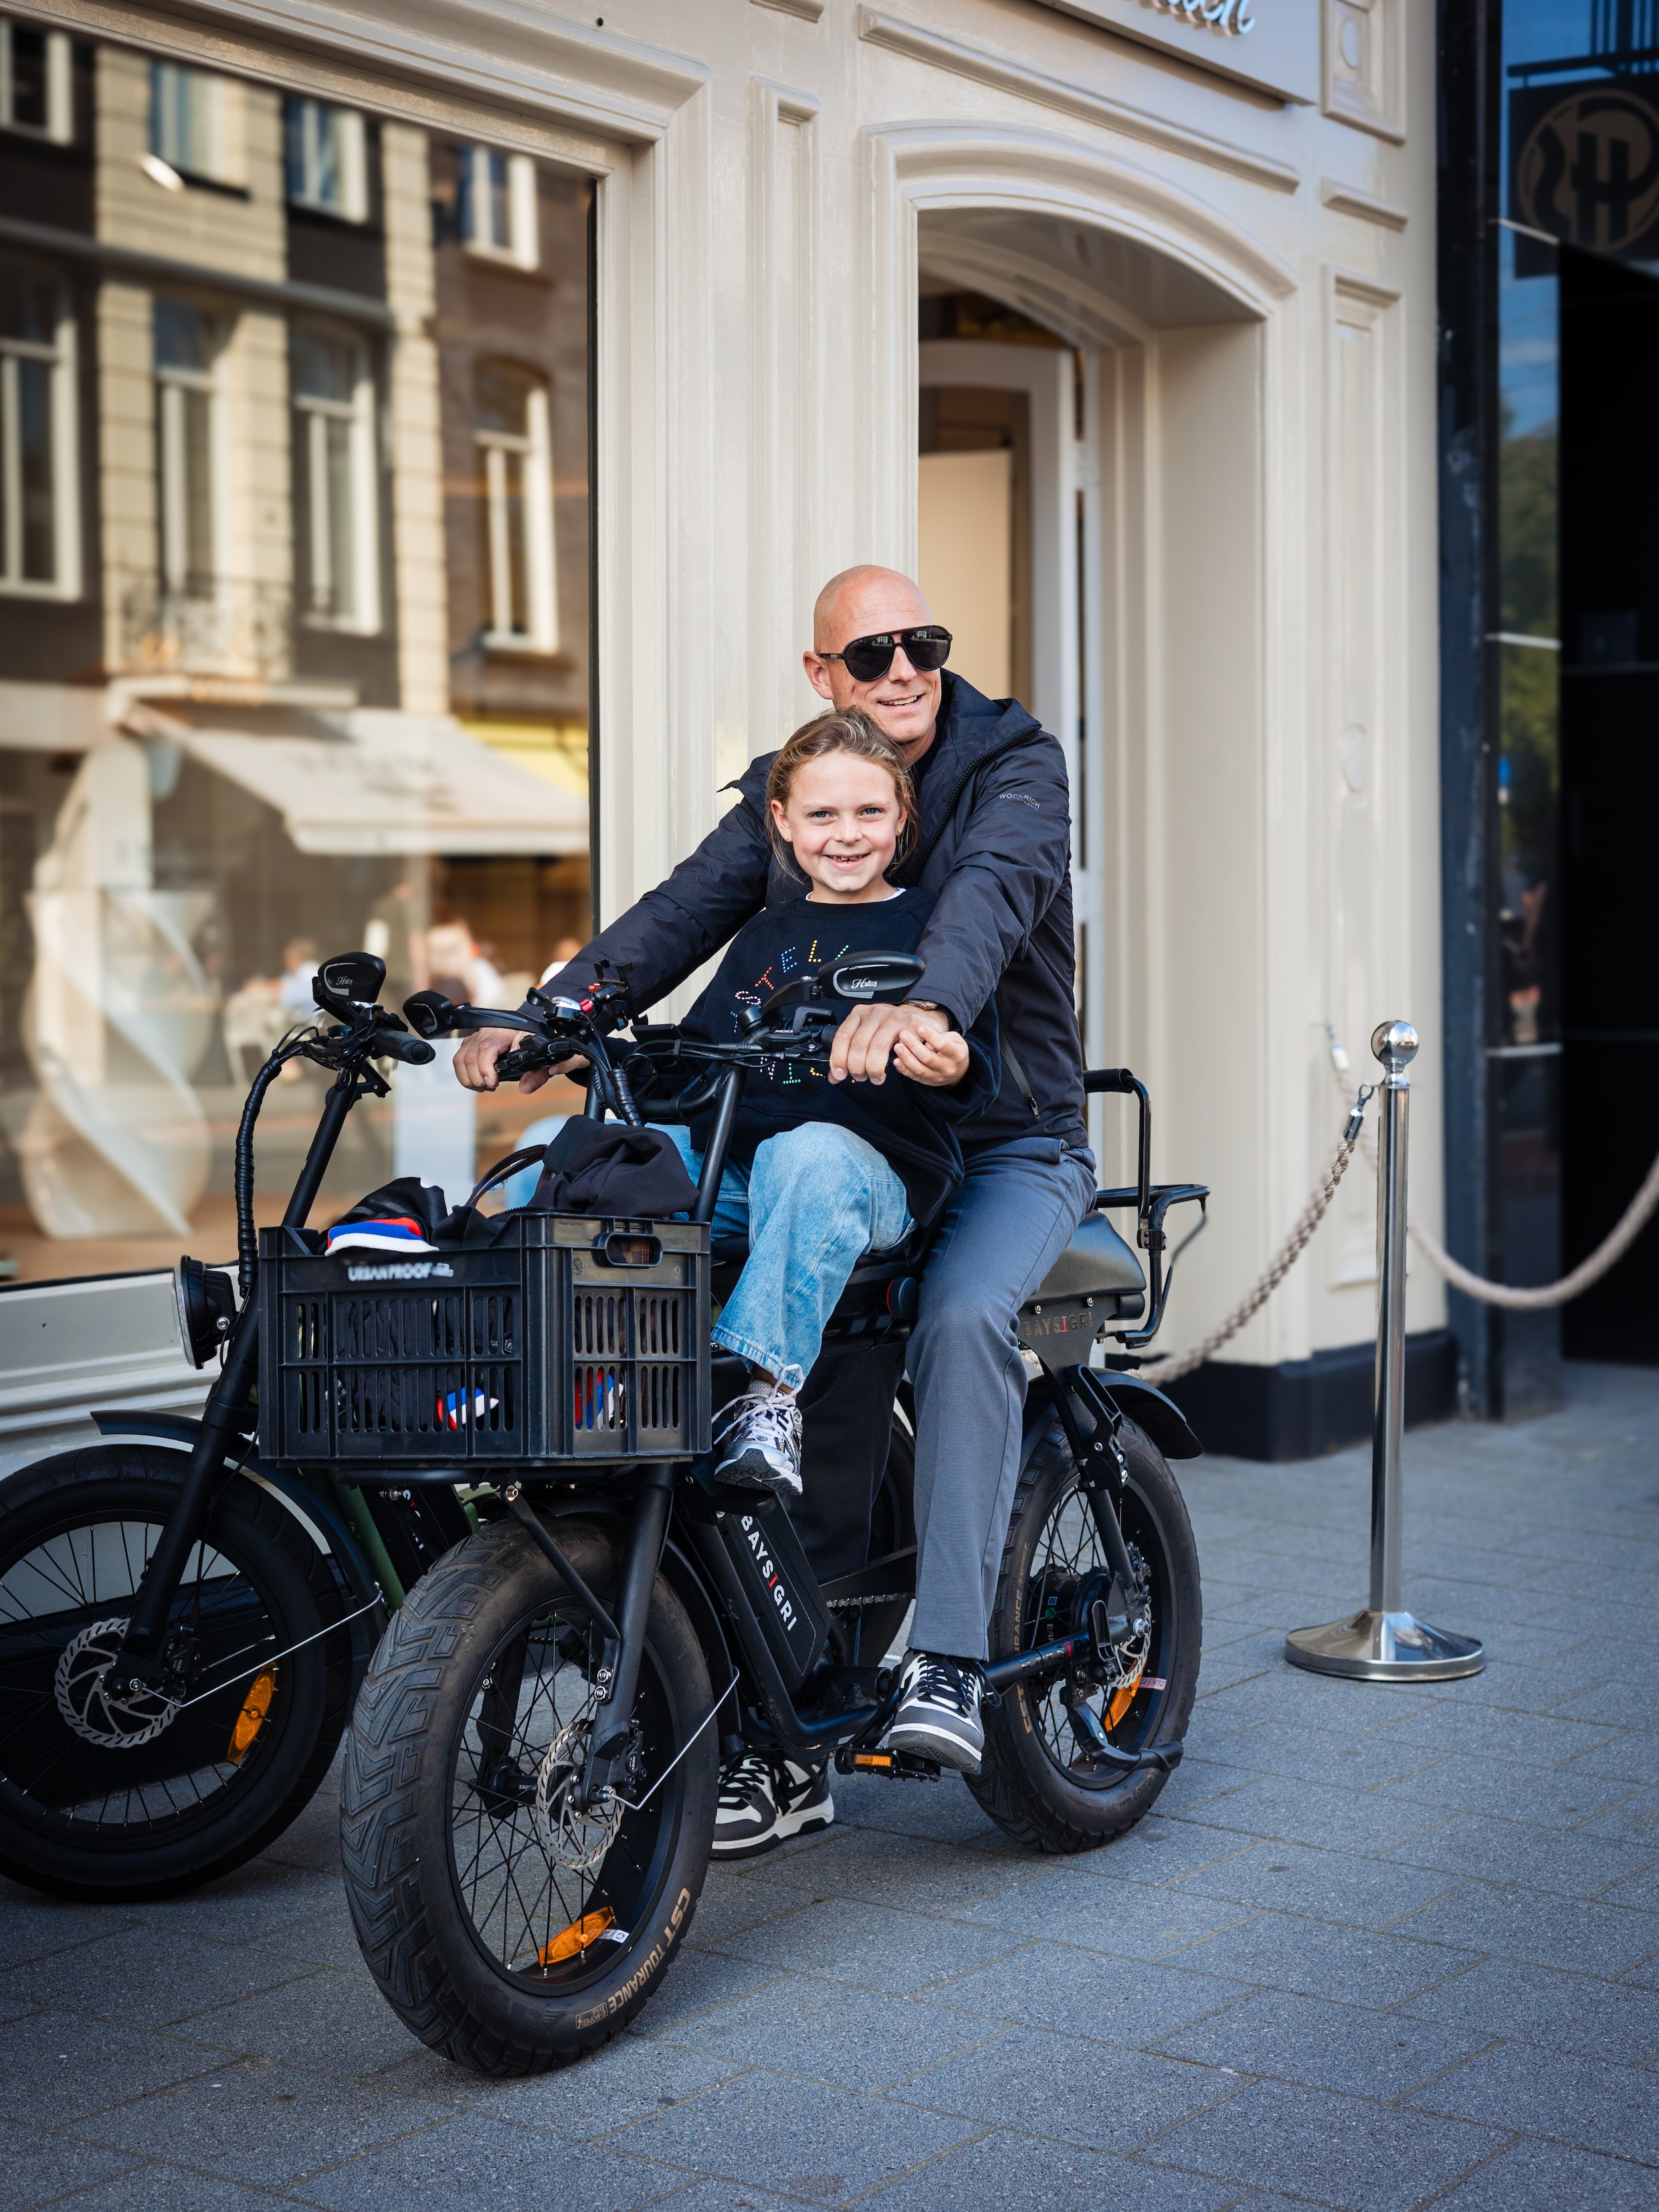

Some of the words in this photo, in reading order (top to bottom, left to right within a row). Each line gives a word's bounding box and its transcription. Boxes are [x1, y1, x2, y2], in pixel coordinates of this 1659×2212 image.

[1023, 1311, 1094, 1338] BAYSIGRI
[741, 1515, 797, 1631] BAYSIGRI
[664, 1887, 690, 1948] CST
[608, 1944, 666, 2014] TOURANCE
